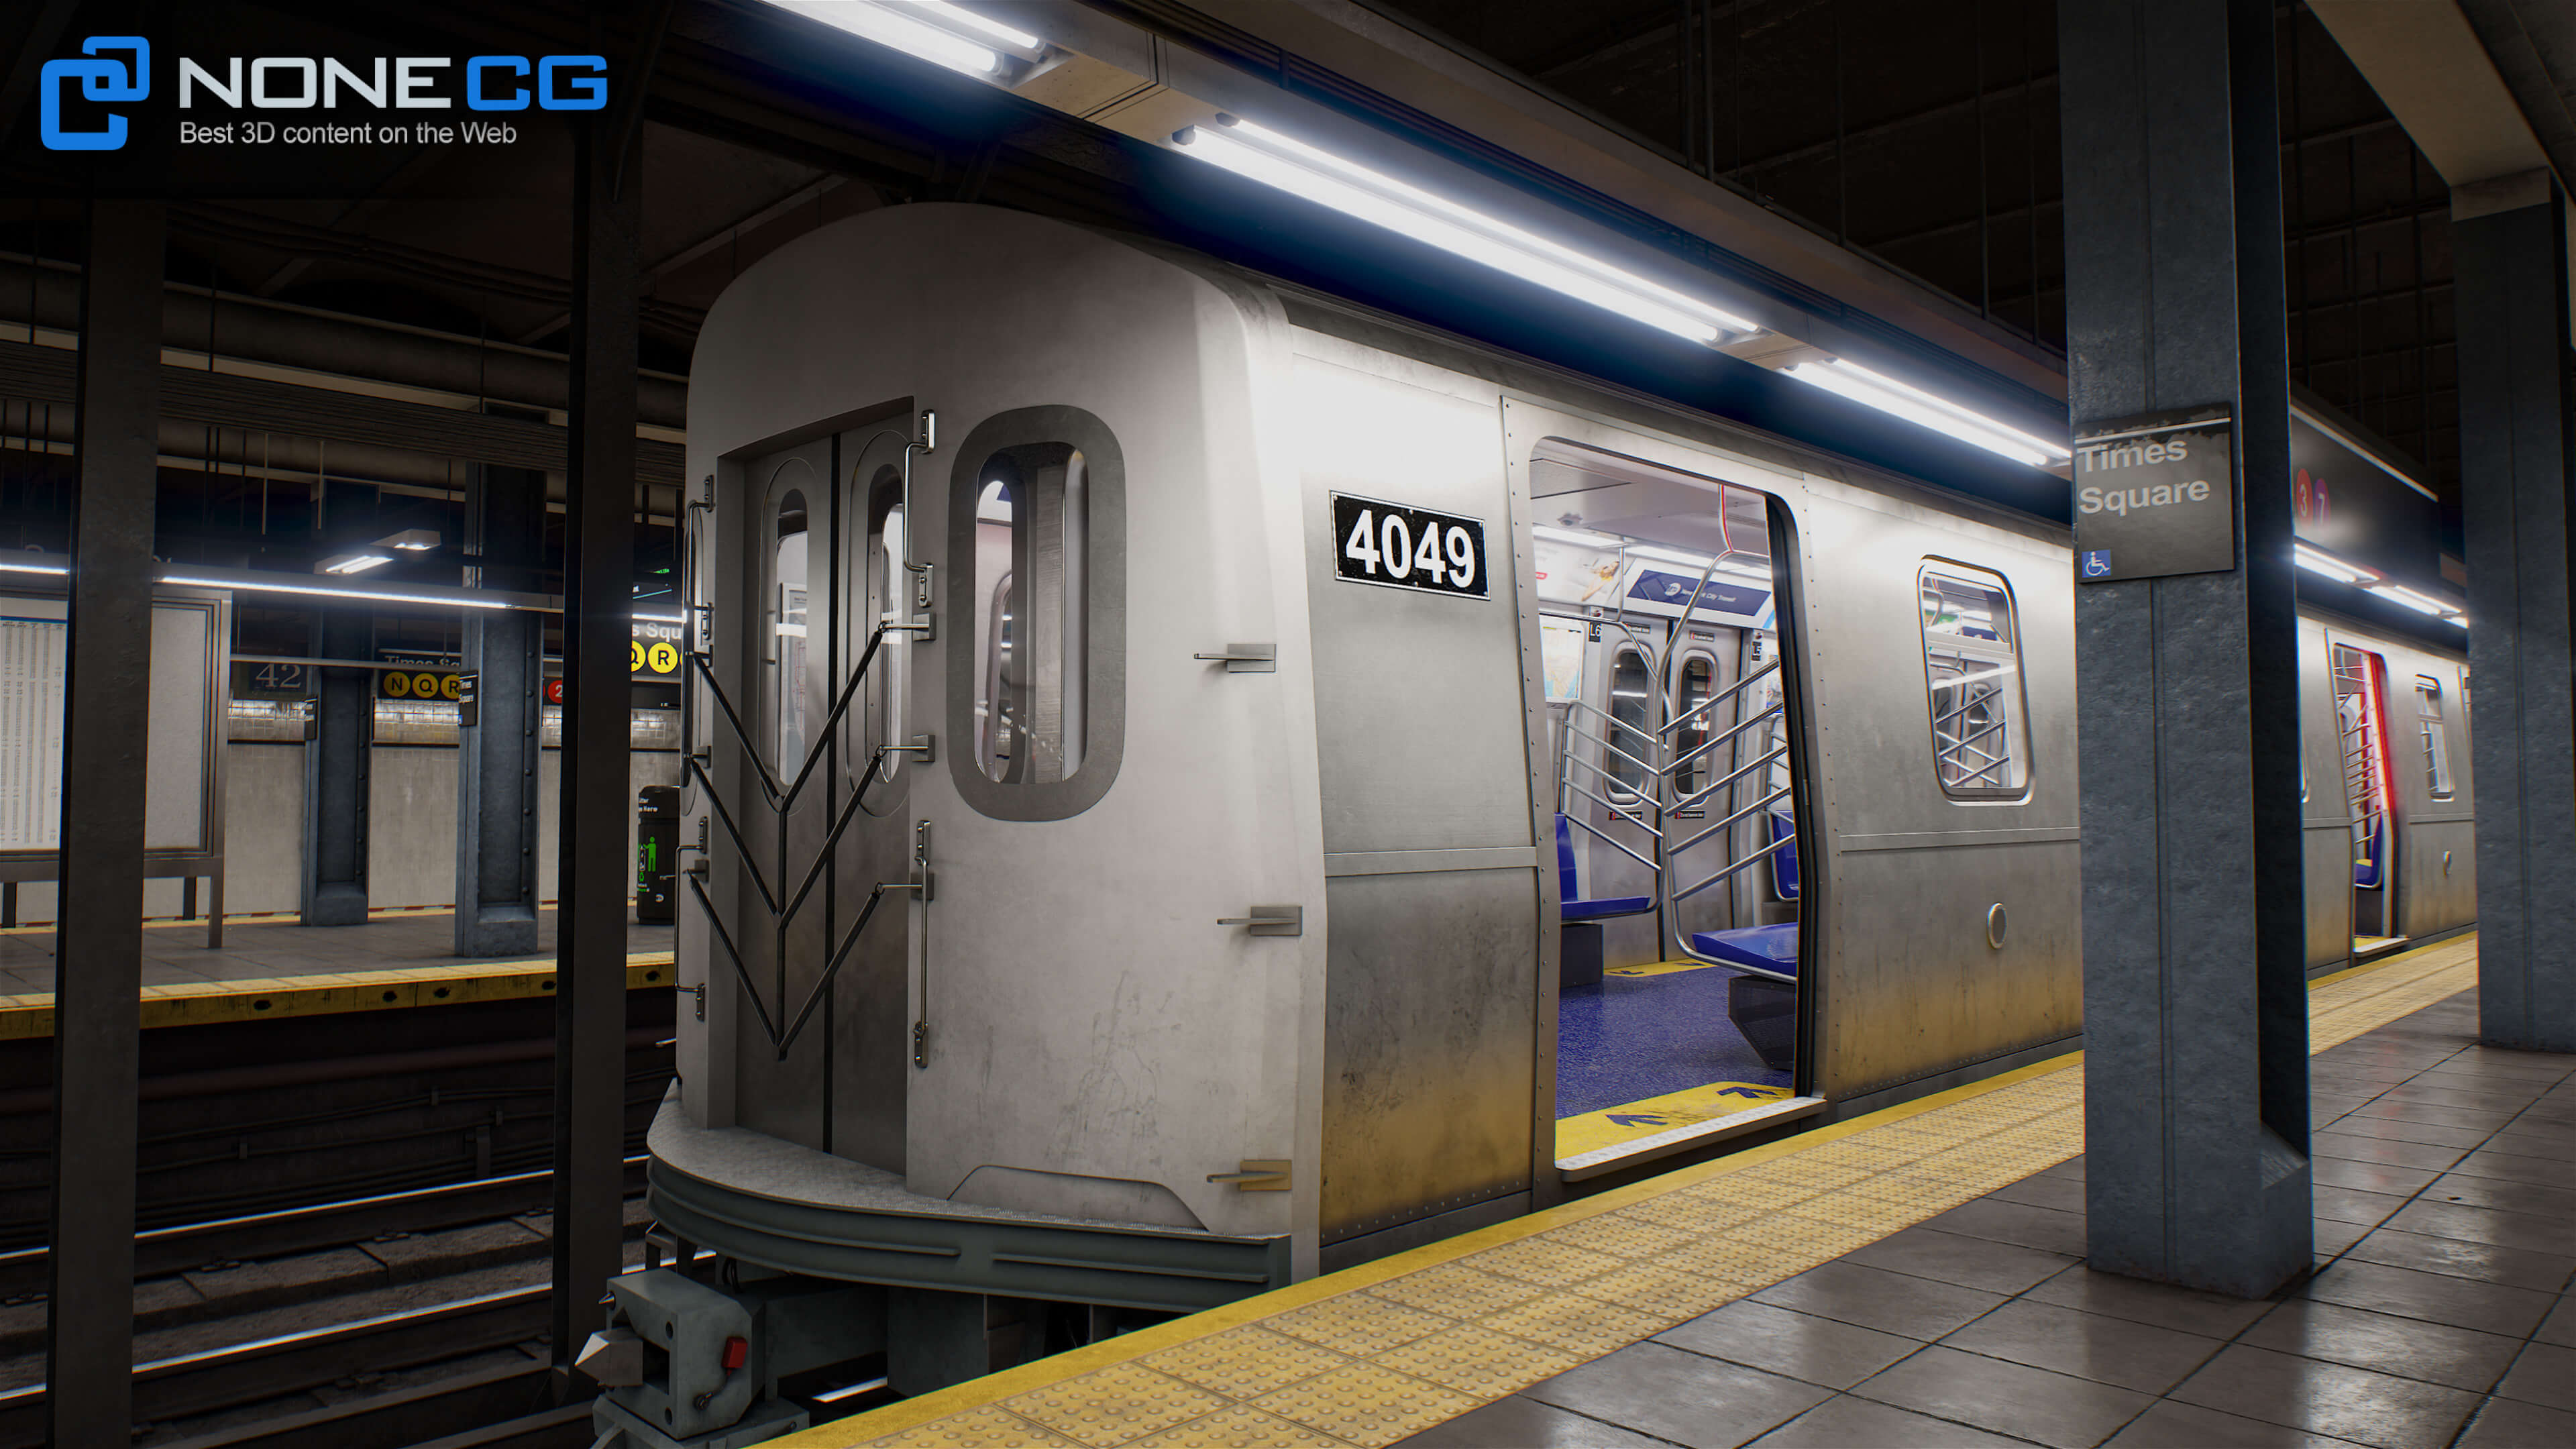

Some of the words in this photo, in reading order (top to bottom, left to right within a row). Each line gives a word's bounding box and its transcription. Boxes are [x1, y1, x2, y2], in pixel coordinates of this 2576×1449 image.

[2076, 440, 2188, 473] Times
[2079, 480, 2210, 517] Square
[2300, 484, 2308, 518] 3
[2318, 492, 2326, 525] 7
[1346, 509, 1475, 588] 4049
[657, 649, 669, 666] R
[256, 663, 301, 689] 42
[391, 678, 403, 692] N
[419, 678, 433, 694] Q
[449, 680, 460, 694] R
